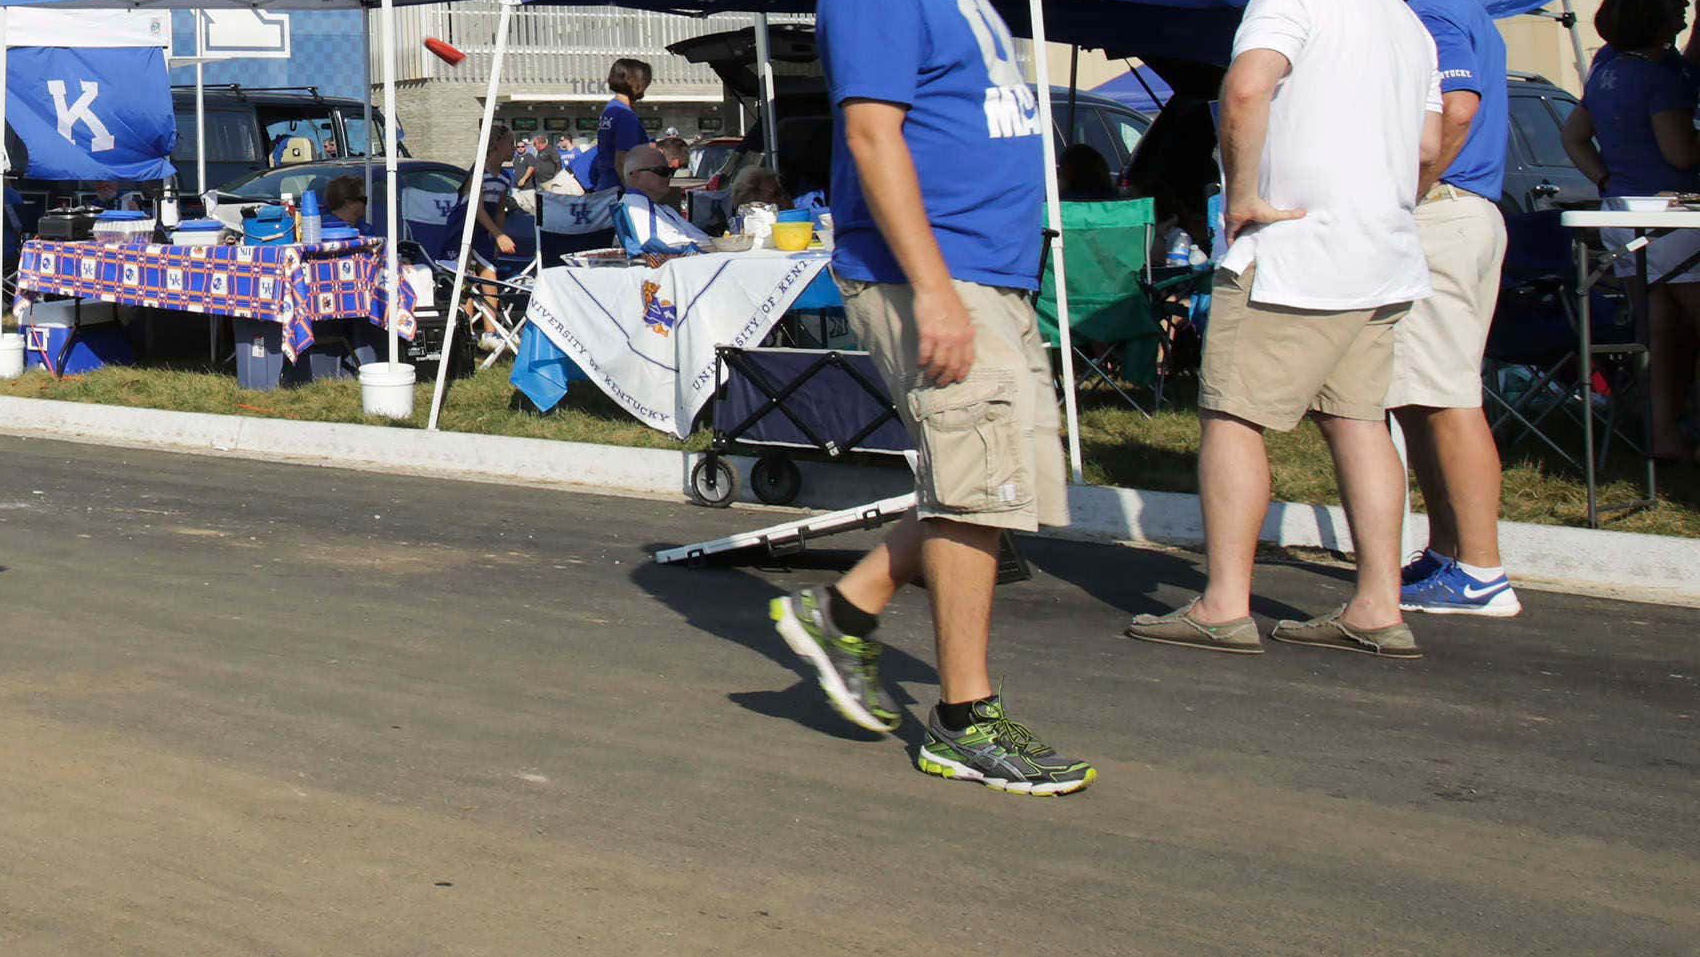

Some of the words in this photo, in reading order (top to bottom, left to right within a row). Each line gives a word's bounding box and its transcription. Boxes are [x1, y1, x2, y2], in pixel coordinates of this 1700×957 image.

[571, 79, 610, 94] TICK
[47, 79, 114, 152] K
[761, 298, 776, 315] OF
[603, 374, 671, 423] KENTUCKY
